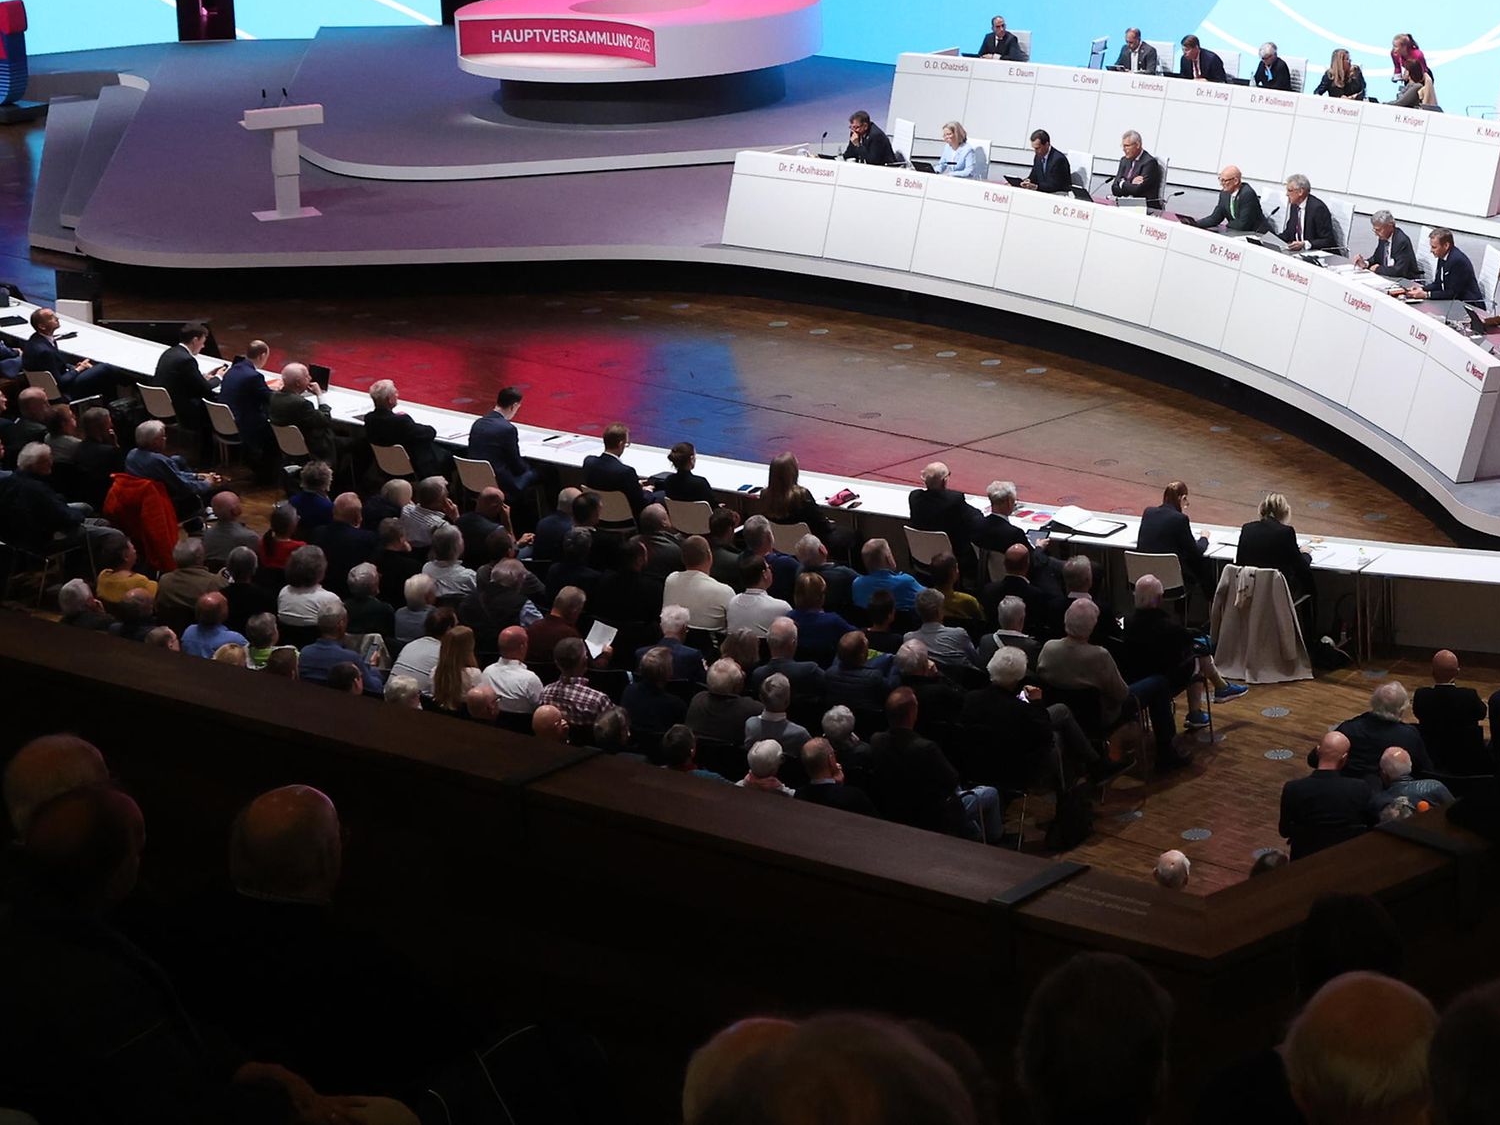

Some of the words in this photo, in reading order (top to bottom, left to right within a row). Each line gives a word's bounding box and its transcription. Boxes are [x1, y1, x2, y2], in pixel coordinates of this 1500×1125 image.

[491, 29, 633, 48] HAUPTVERSAMMLUNG
[633, 36, 650, 53] 2025
[1008, 67, 1015, 76] E.
[1073, 74, 1080, 83] C.
[1081, 75, 1099, 85] Greve
[1131, 81, 1137, 90] L.
[1196, 88, 1205, 97] Dr.
[1206, 89, 1213, 98] H.
[1214, 90, 1229, 101] Jung
[1395, 114, 1402, 124] H.
[1477, 128, 1484, 136] K.
[779, 162, 787, 173] Dr.
[796, 165, 834, 177] Abolhassan
[896, 177, 902, 187] B.
[904, 178, 923, 190] Bohle
[984, 191, 991, 201] R.
[1053, 205, 1061, 215] Dr.
[1062, 206, 1069, 217] C.
[1209, 244, 1218, 254] Dr.
[1224, 248, 1241, 262] Appel
